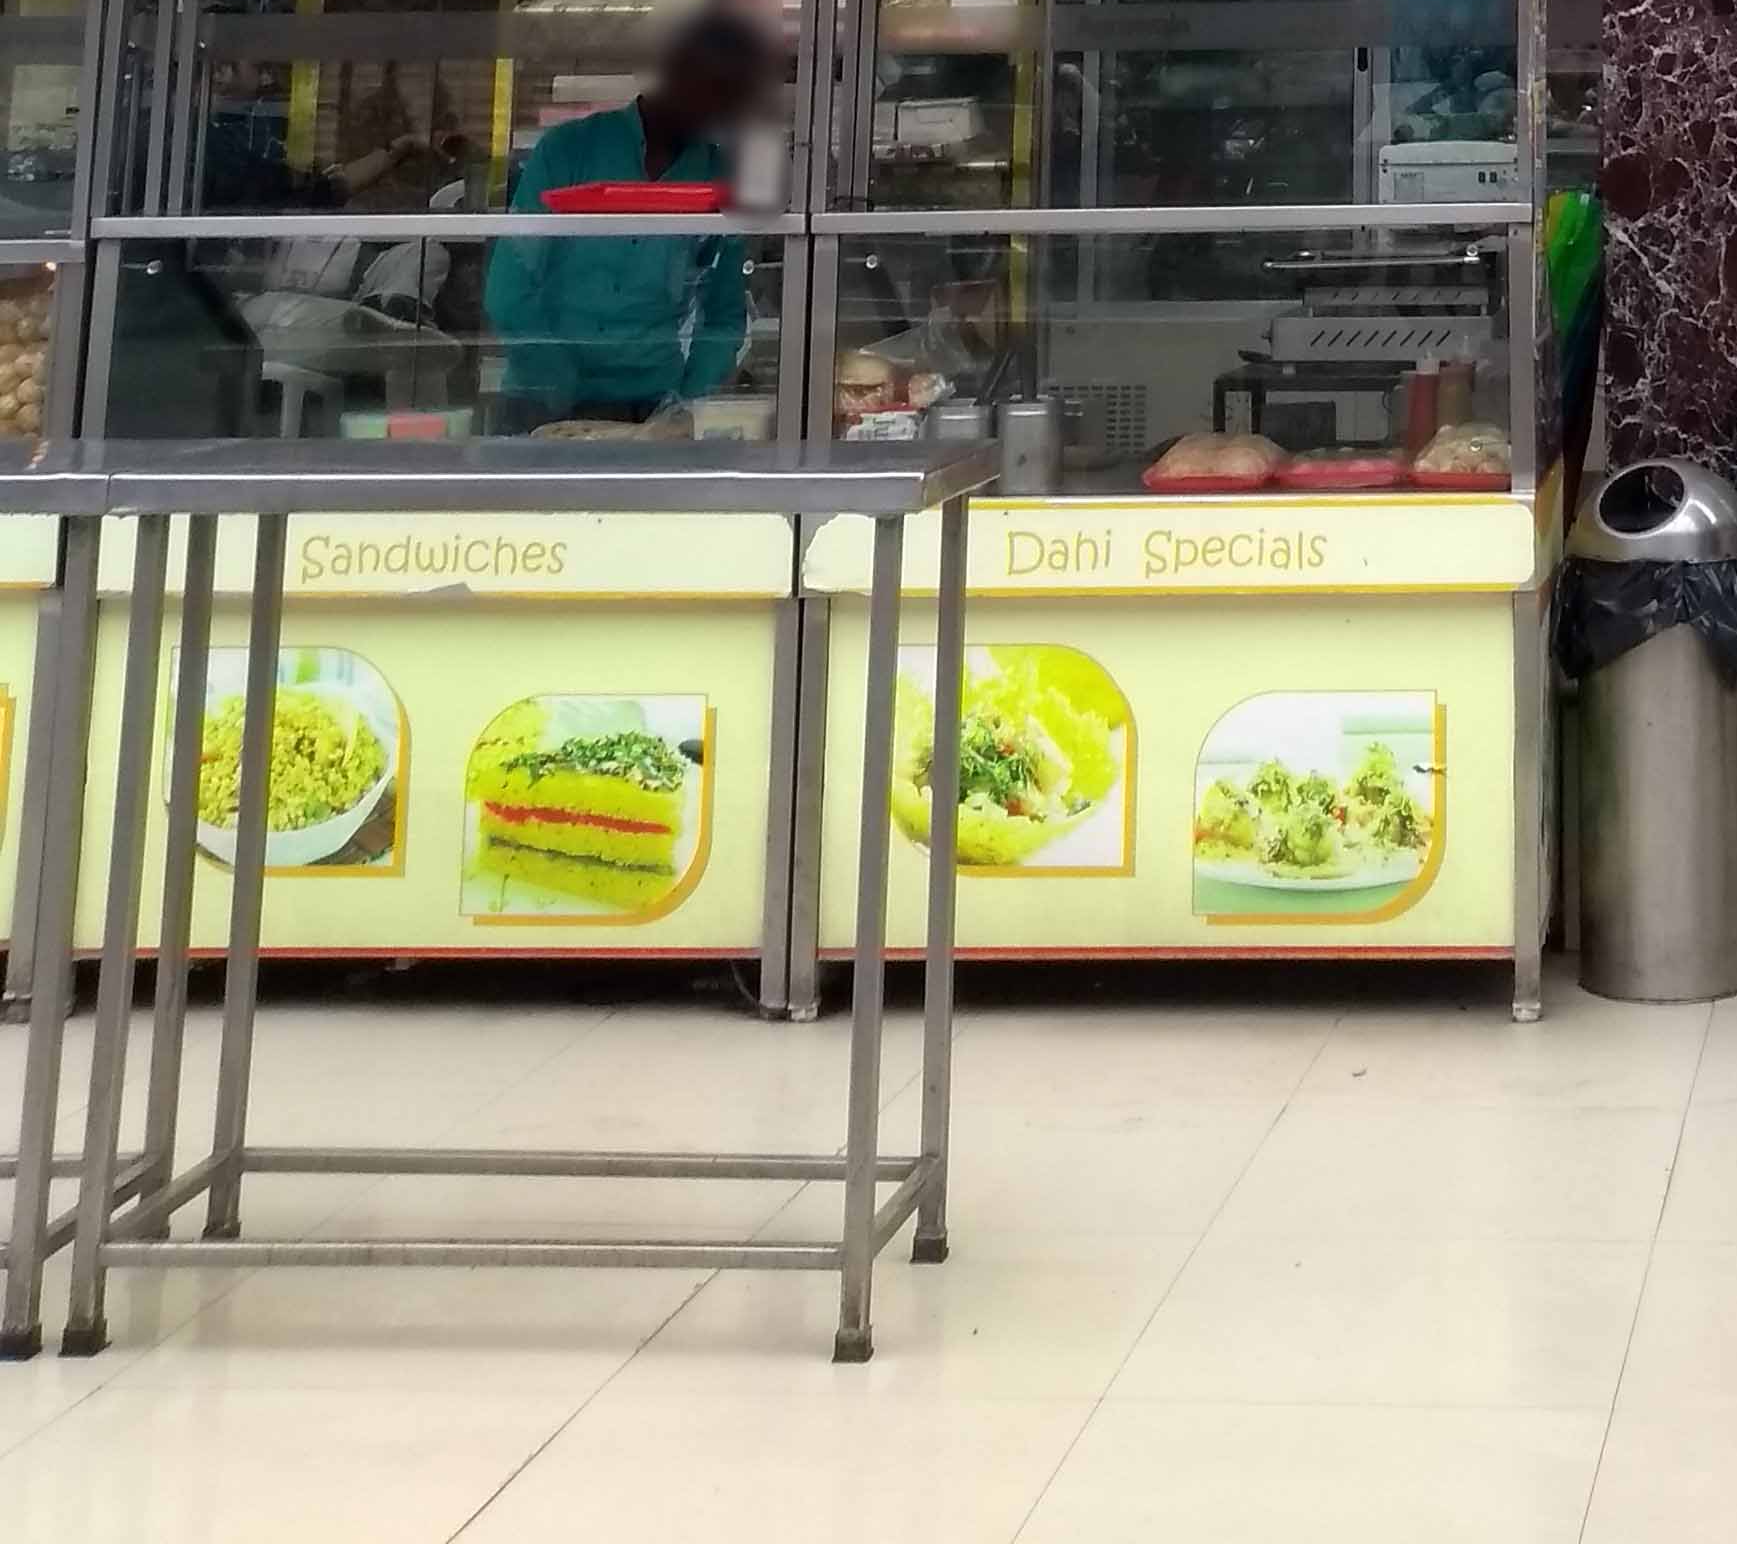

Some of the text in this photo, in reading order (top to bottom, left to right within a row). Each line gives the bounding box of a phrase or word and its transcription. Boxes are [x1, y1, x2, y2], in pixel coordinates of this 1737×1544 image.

[301, 535, 568, 584] Sandwiches
[1007, 527, 1328, 579] Dahi Specials
